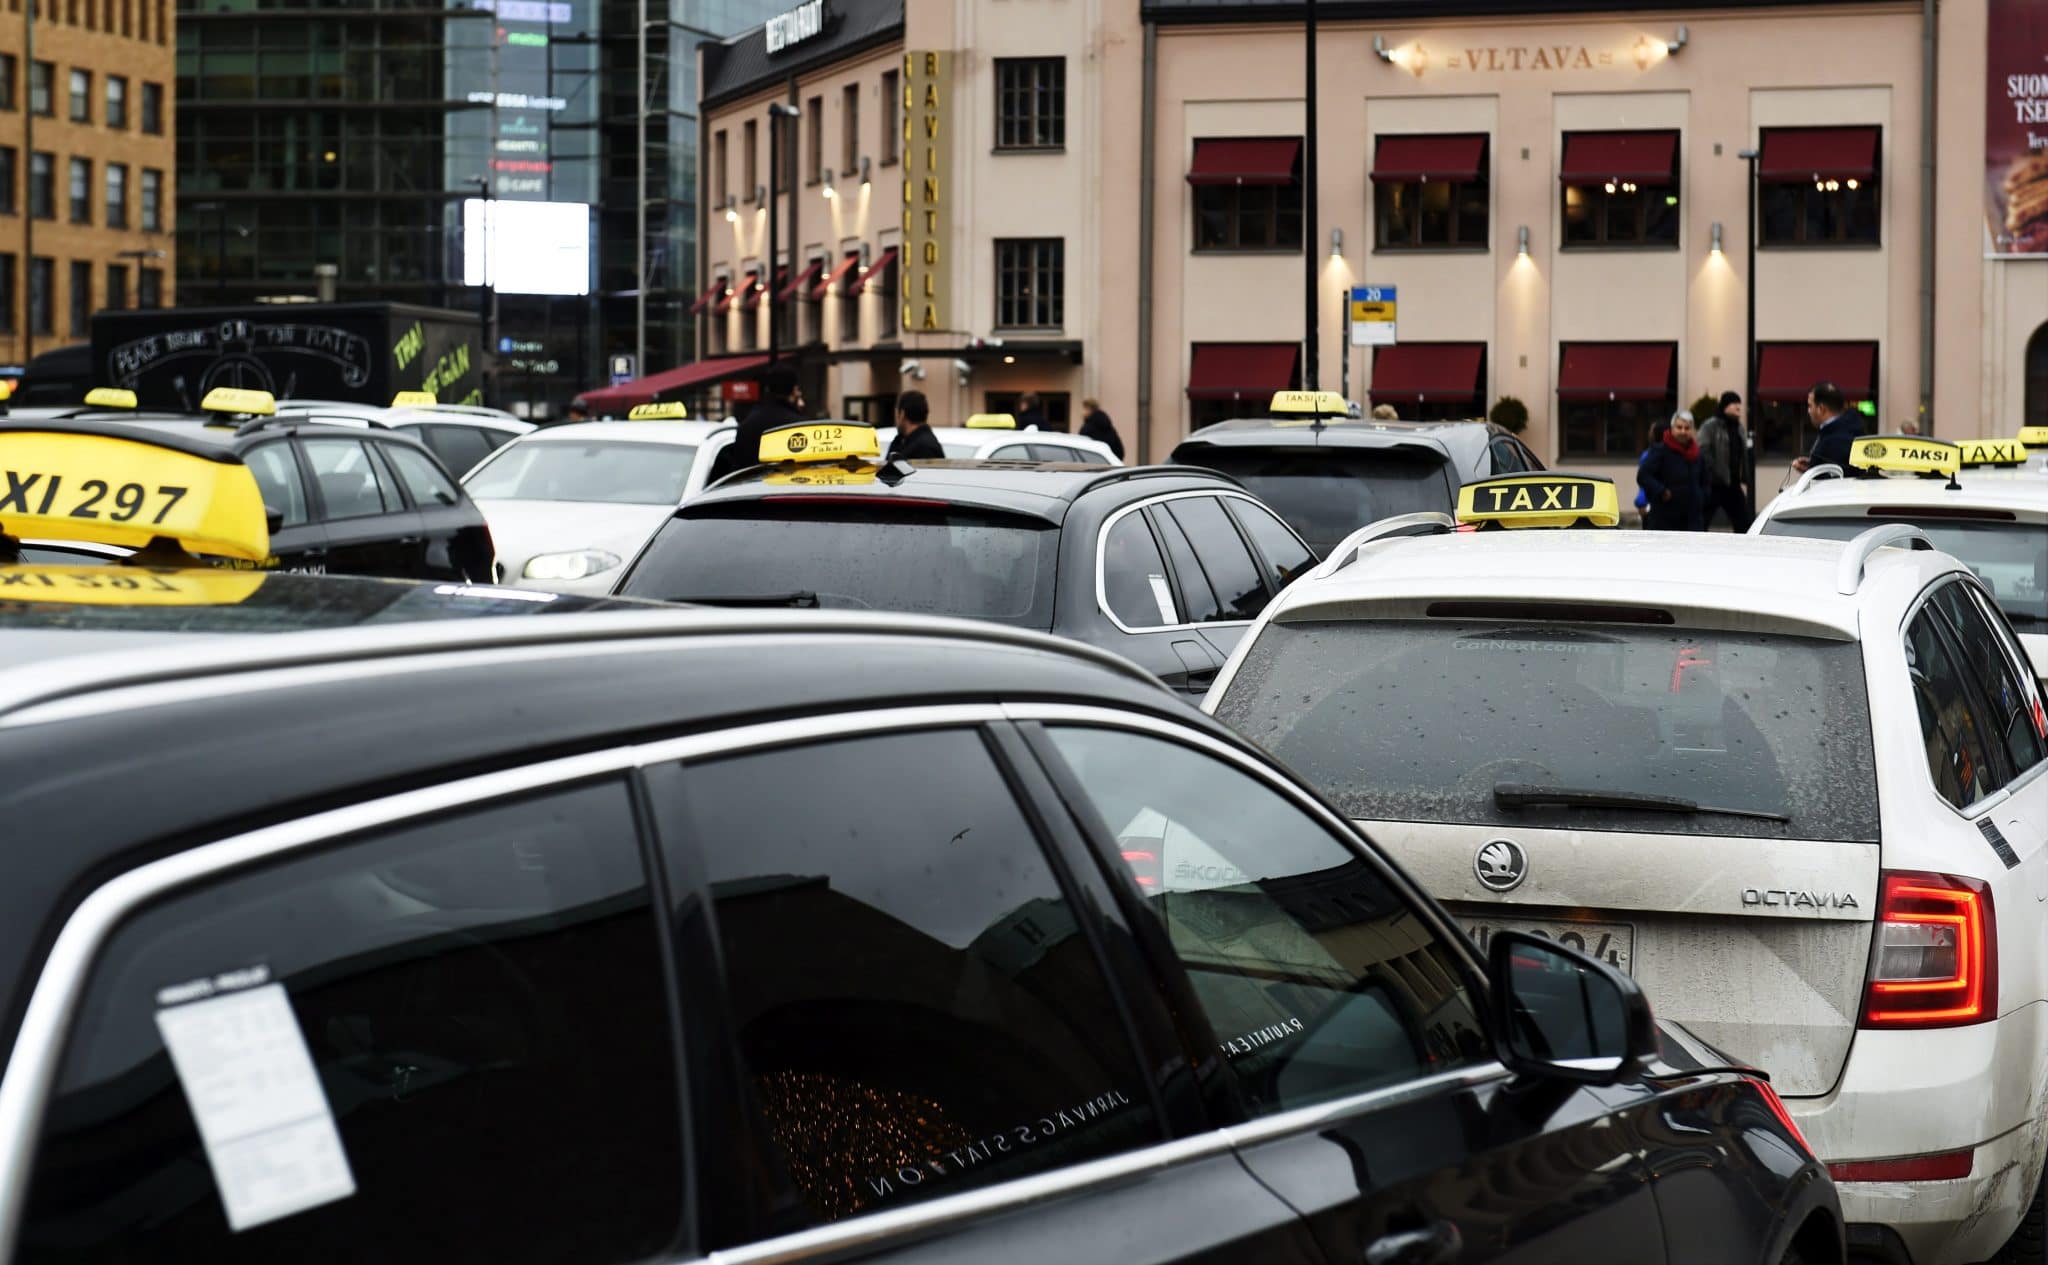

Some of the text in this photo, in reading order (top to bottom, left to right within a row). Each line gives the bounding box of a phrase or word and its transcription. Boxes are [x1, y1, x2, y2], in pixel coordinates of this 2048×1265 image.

[1465, 47, 1593, 72] VLTAVA
[923, 51, 939, 329] RAVINTOLA
[1366, 287, 1382, 301] 20
[813, 428, 842, 440] 012
[811, 444, 844, 453] Taksi
[1899, 447, 1949, 462] TAKSI
[70, 479, 188, 524] 297
[1488, 485, 1579, 511] TAXI
[1451, 639, 1587, 654] CarNext.com
[1741, 889, 1859, 909] OCTAVIA
